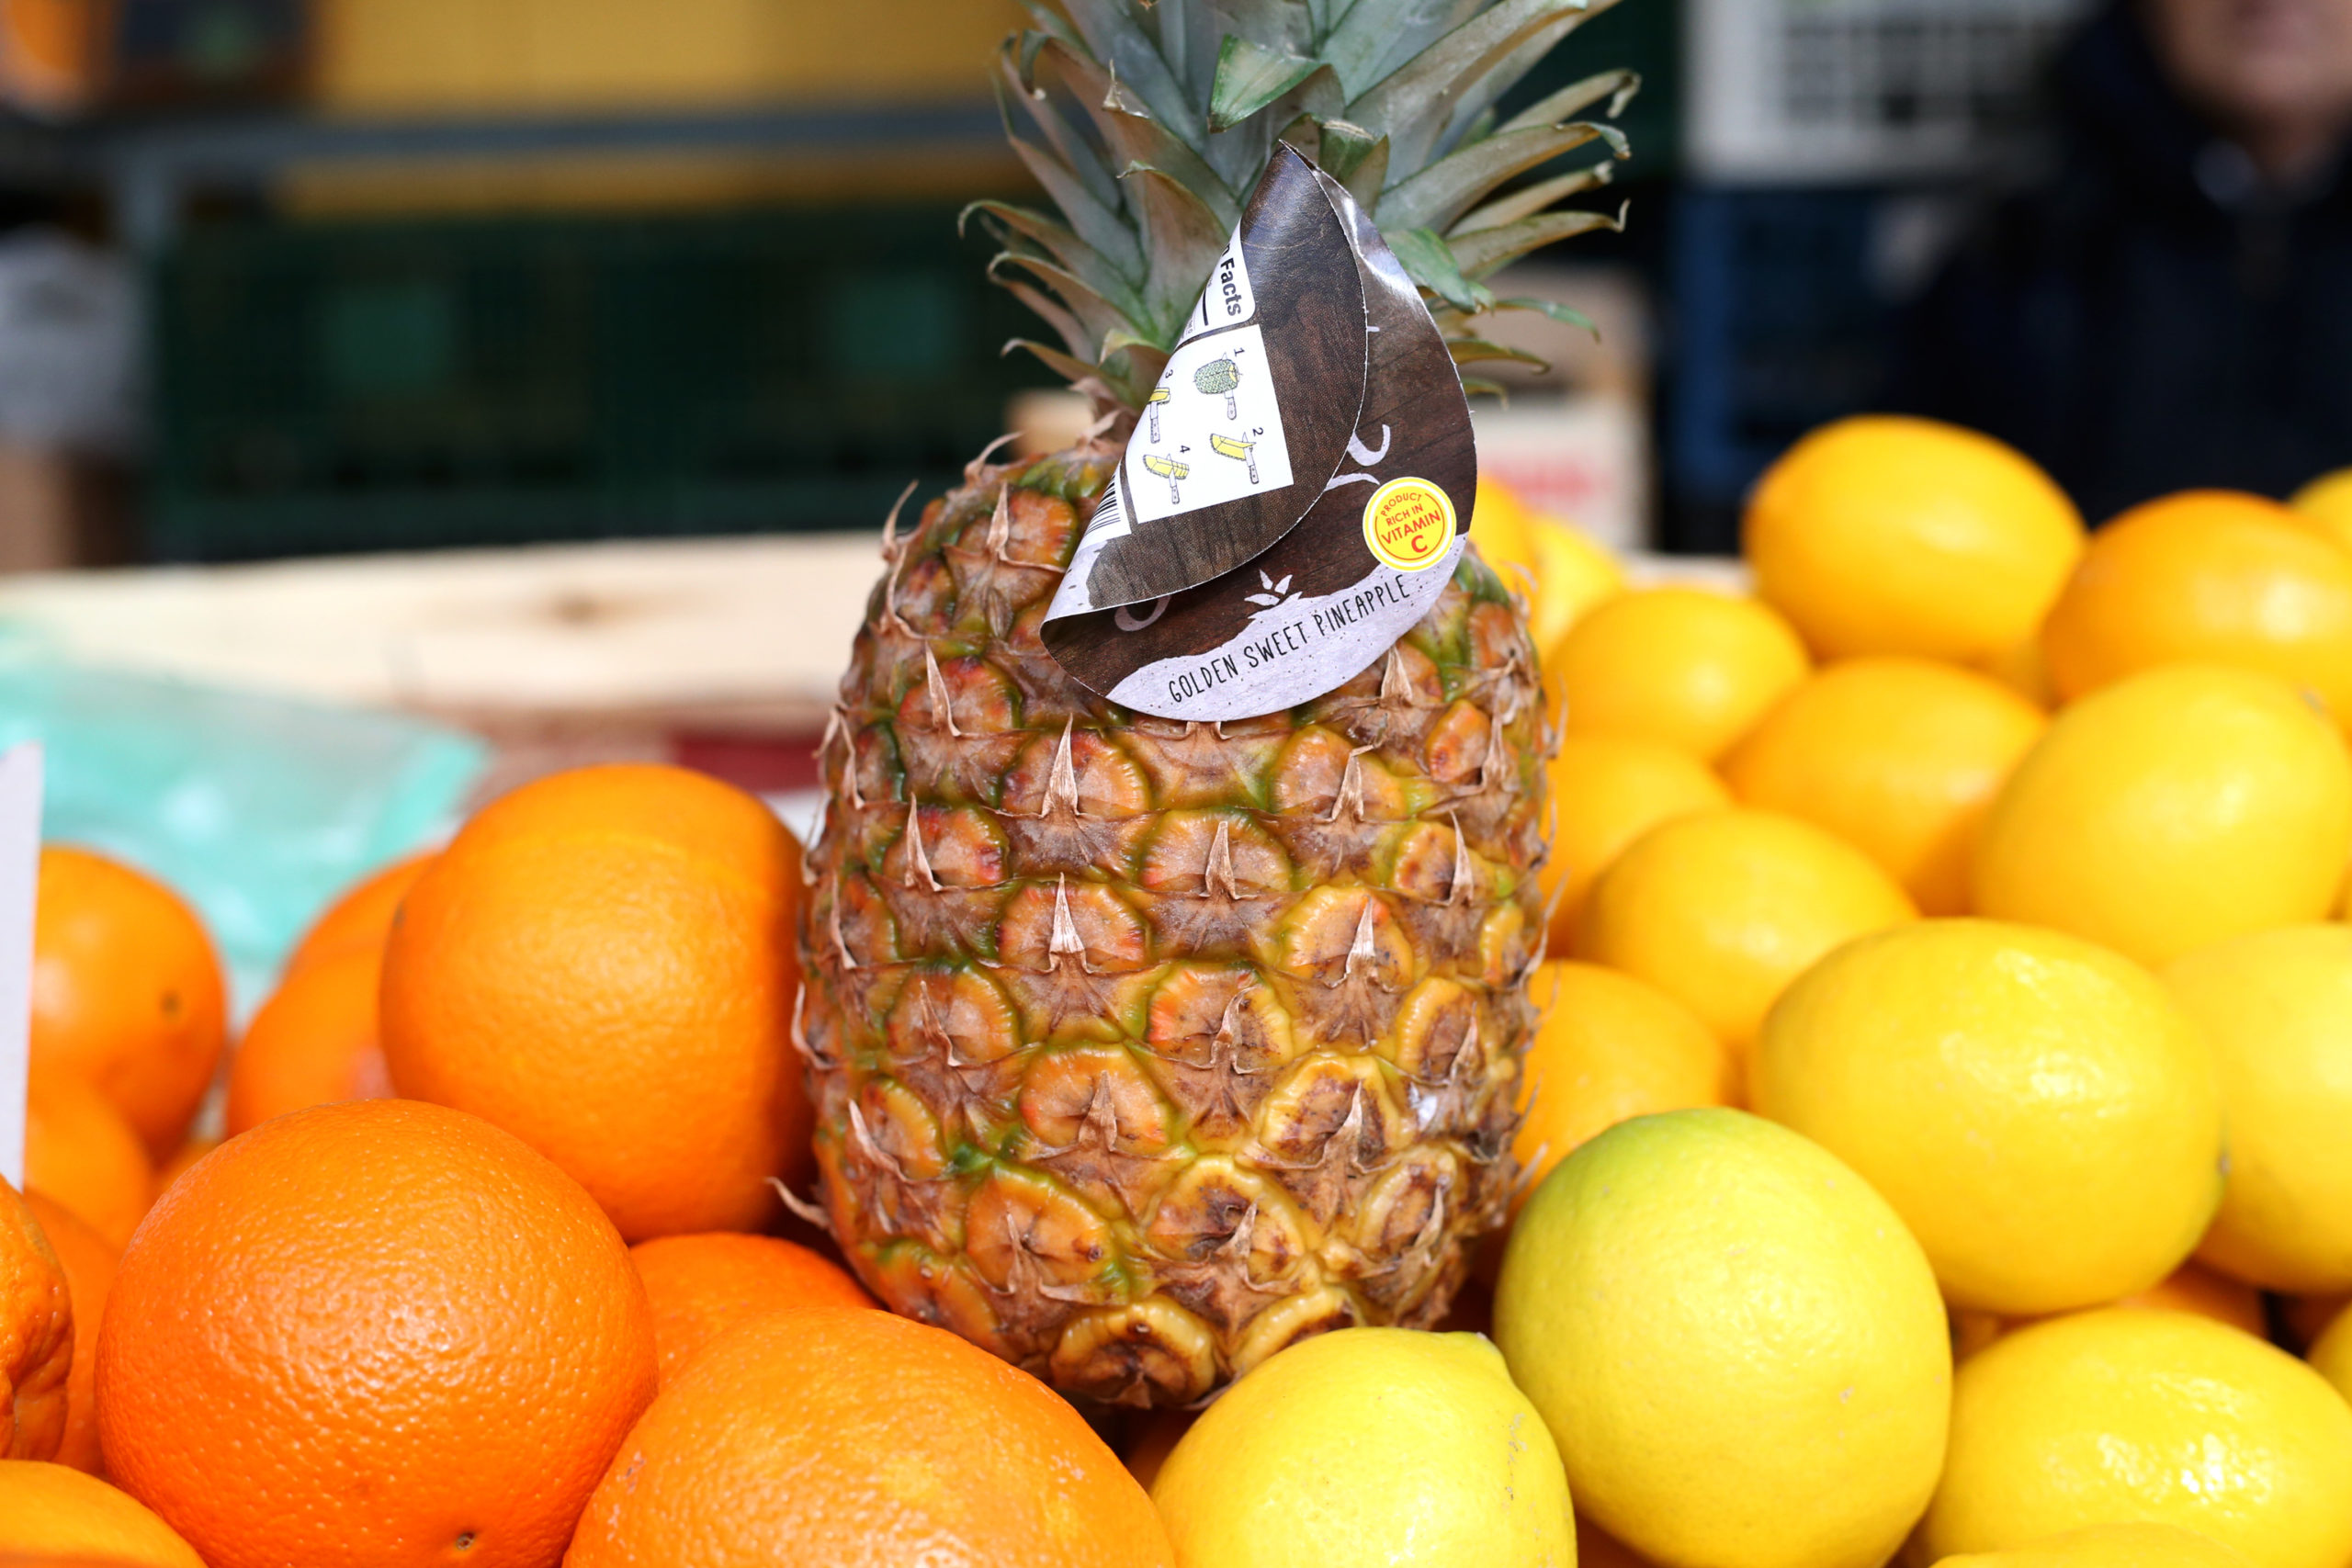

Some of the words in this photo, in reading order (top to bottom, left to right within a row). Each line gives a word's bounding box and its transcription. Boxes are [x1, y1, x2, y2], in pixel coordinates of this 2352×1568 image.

[1220, 257, 1242, 316] Facts
[1234, 347, 1245, 356] 1
[1165, 369, 1173, 378] 3
[1252, 427, 1263, 436] 2
[1180, 445, 1191, 454] 4
[1380, 492, 1421, 516] PRODUCT
[1385, 509, 1410, 526] RICH
[1411, 503, 1423, 514] IN
[1381, 510, 1441, 544] VITAMIN
[1411, 535, 1428, 553] C
[1169, 654, 1238, 703] GOLDEN
[1243, 622, 1307, 668] SWEET
[1314, 574, 1410, 637] PINEAPPLE
